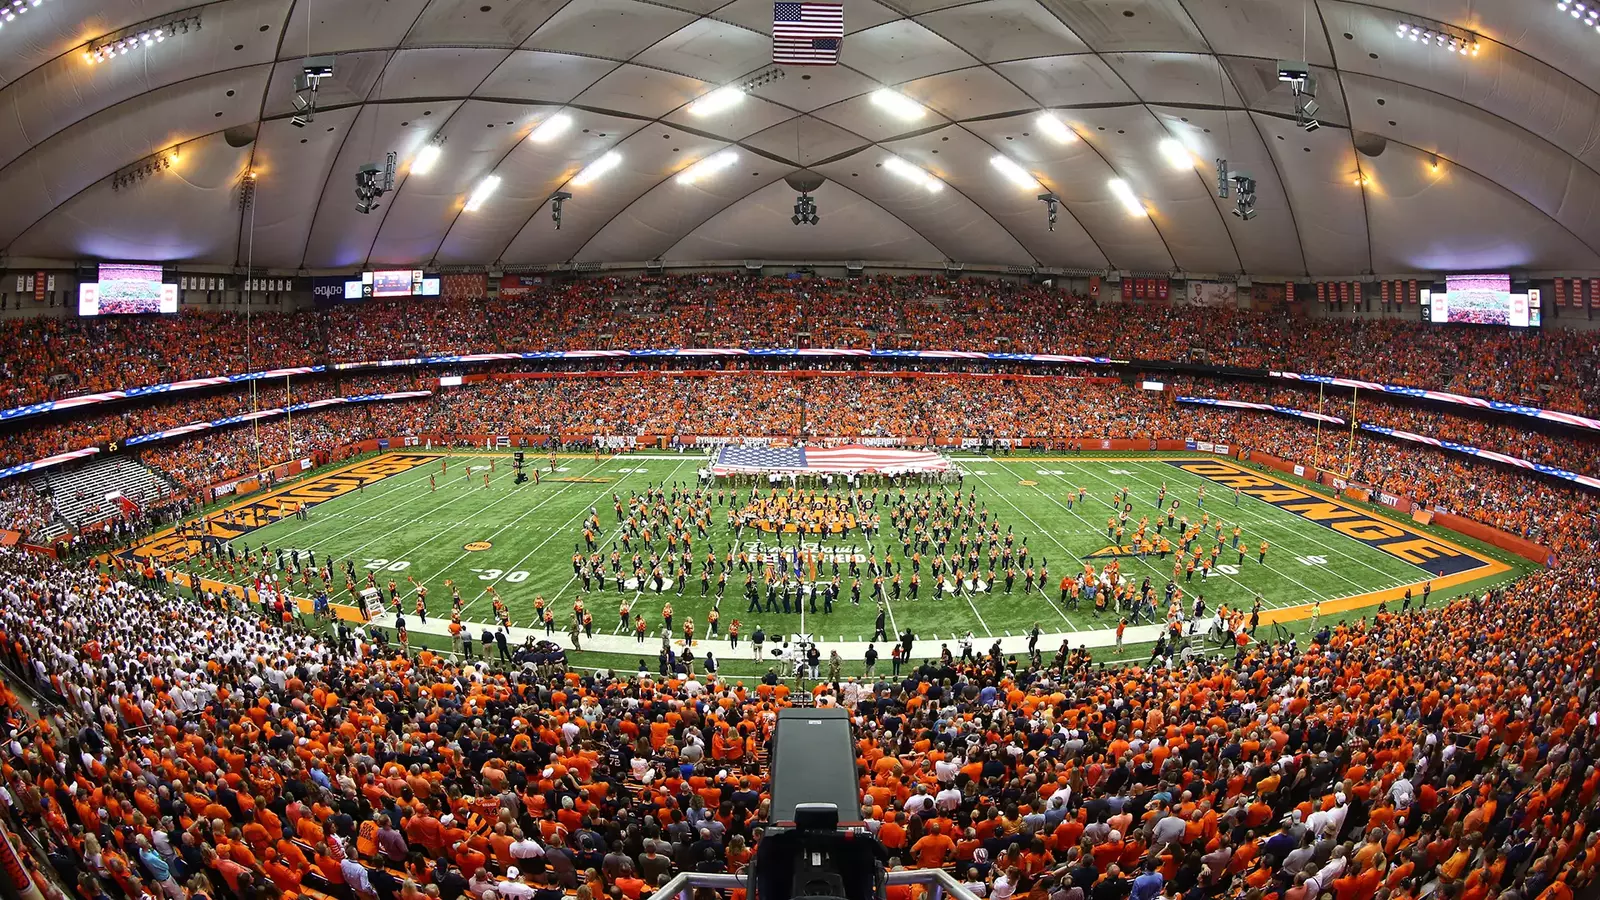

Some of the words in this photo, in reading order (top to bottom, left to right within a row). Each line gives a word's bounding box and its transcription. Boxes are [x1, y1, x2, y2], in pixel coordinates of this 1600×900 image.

[1180, 463, 1462, 564] ORANGE
[364, 558, 411, 572] 20
[1295, 555, 1328, 566] 10
[477, 569, 531, 582] 30
